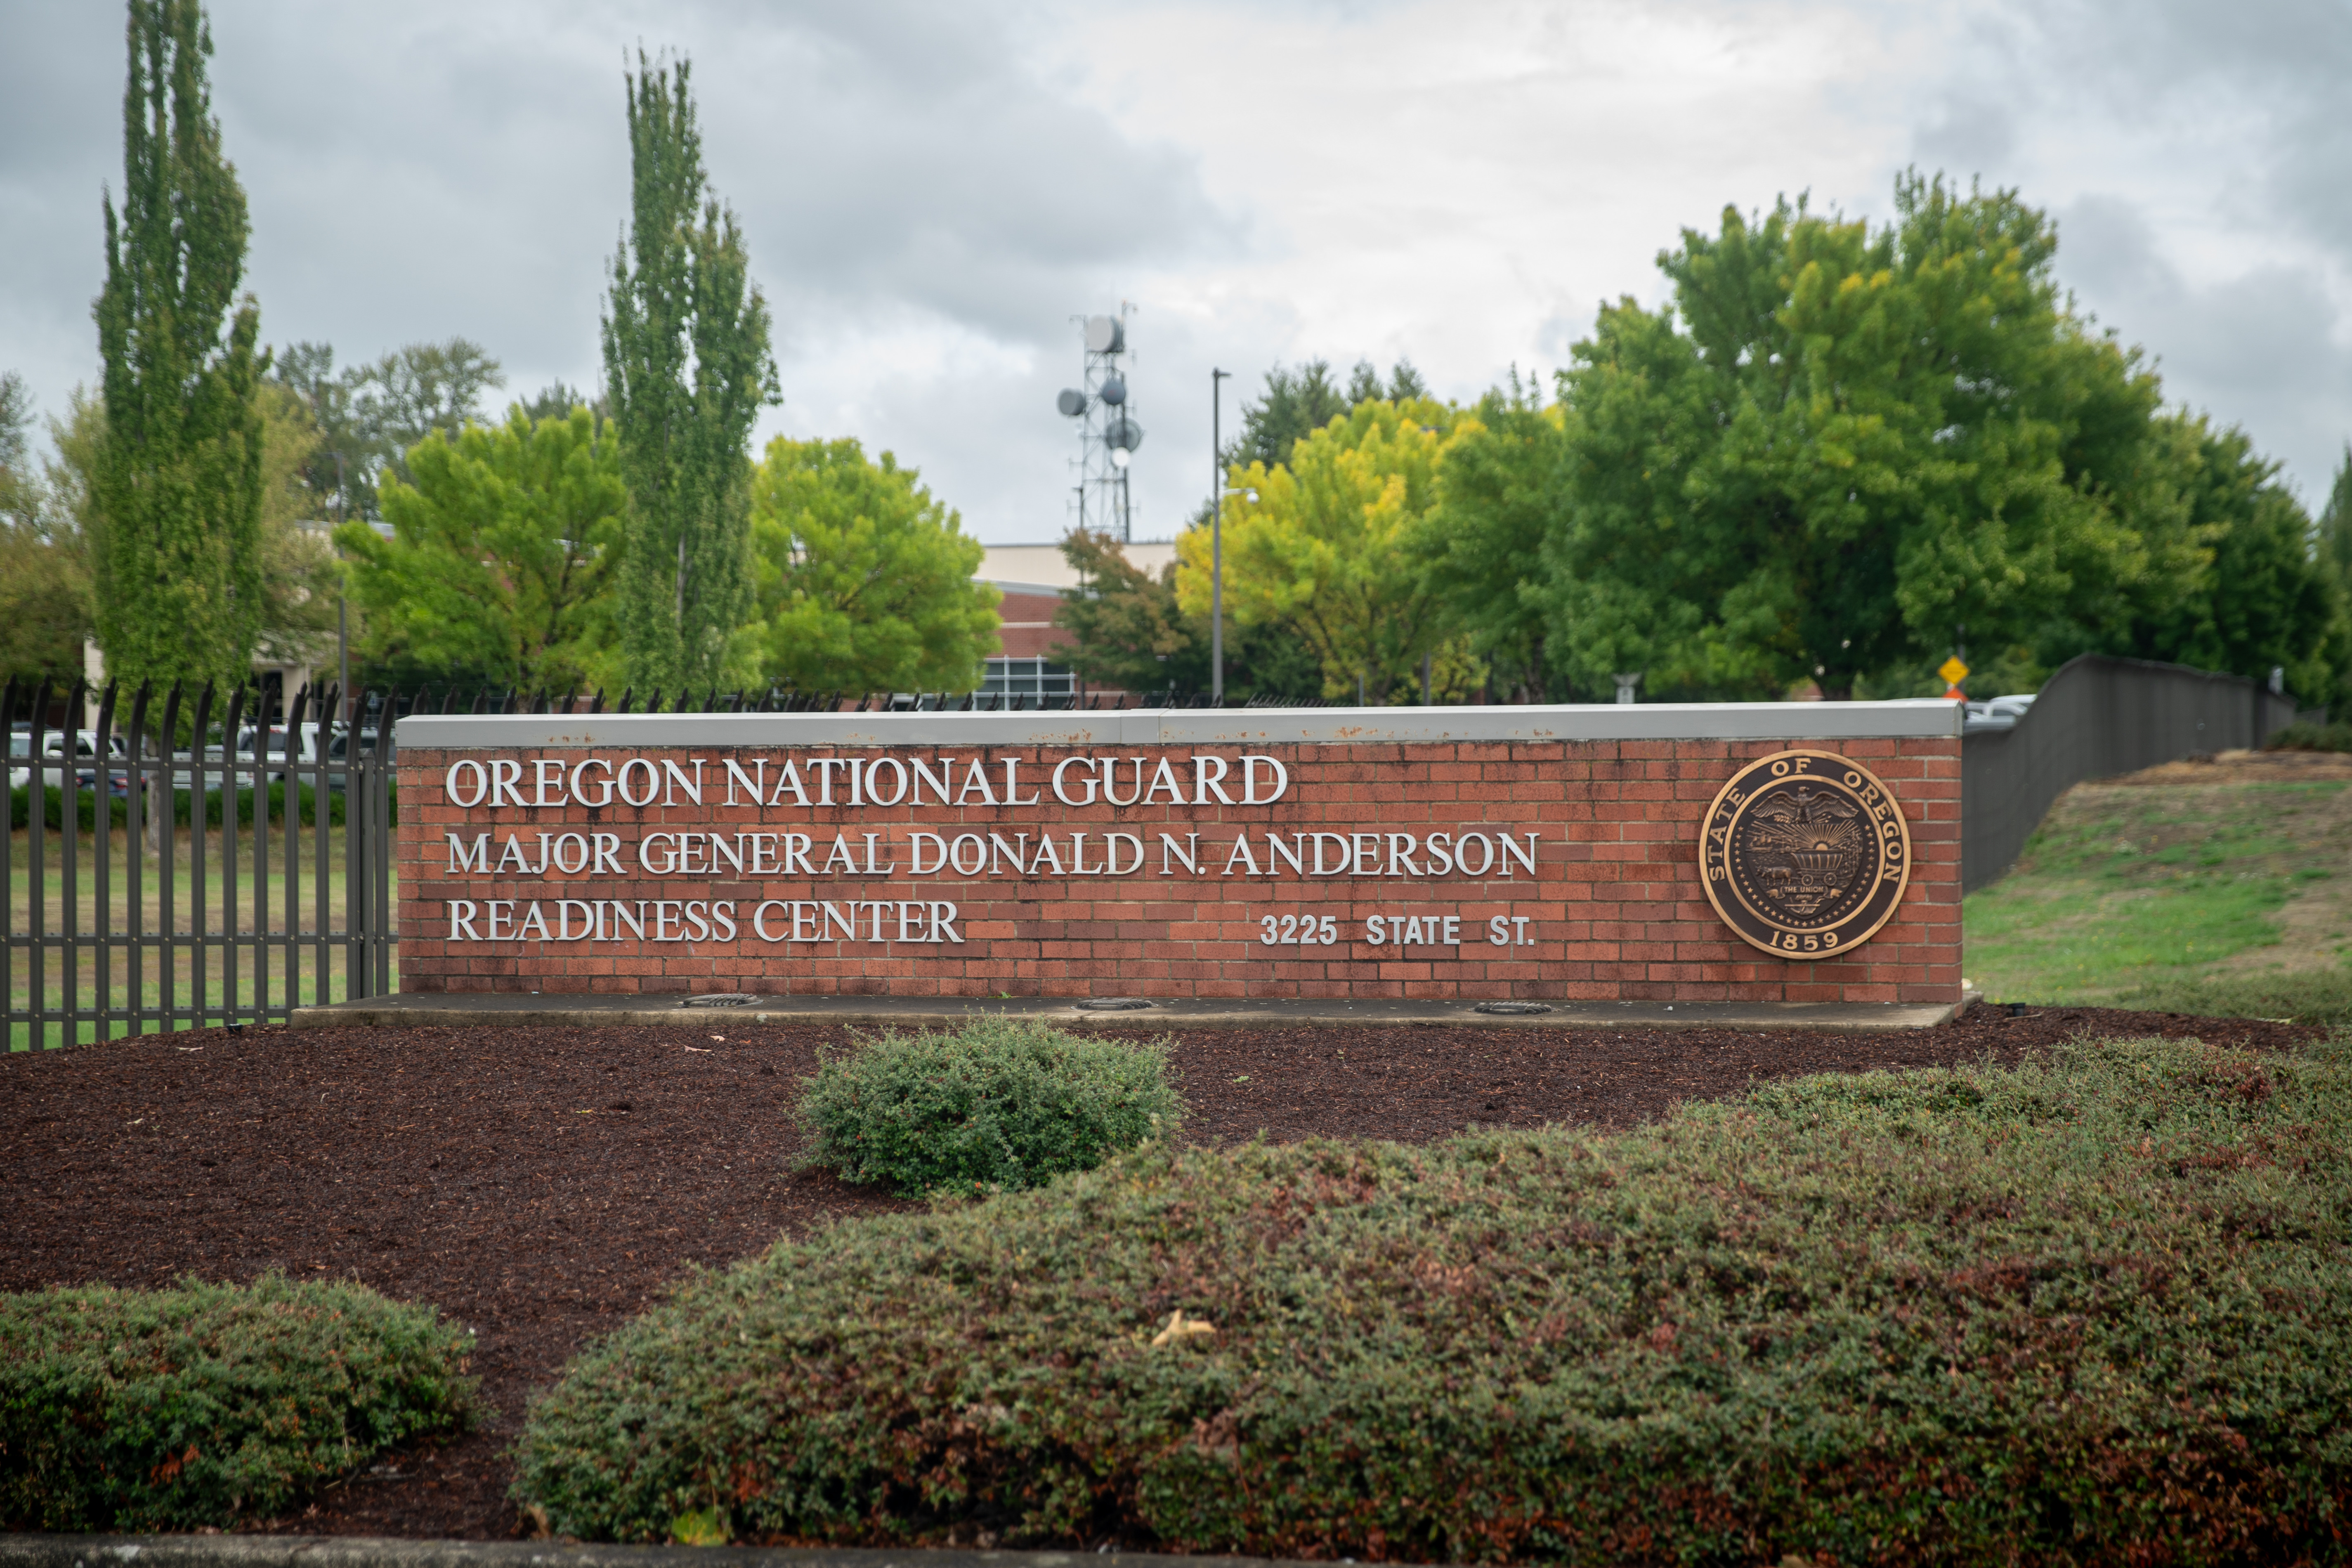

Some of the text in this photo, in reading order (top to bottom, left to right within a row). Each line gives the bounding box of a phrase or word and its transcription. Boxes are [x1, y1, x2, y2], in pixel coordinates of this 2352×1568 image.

[446, 755, 1288, 808] OREGON NATIONAL GUARD
[1707, 758, 1903, 883] STATE OF OREGON
[444, 831, 1541, 876] MAJOR GENERAL DONALD N. ANDERSON
[446, 899, 965, 943] READINESS CENTER
[1260, 914, 1535, 946] 3225 STATE ST.
[1769, 931, 1838, 951] 1859
